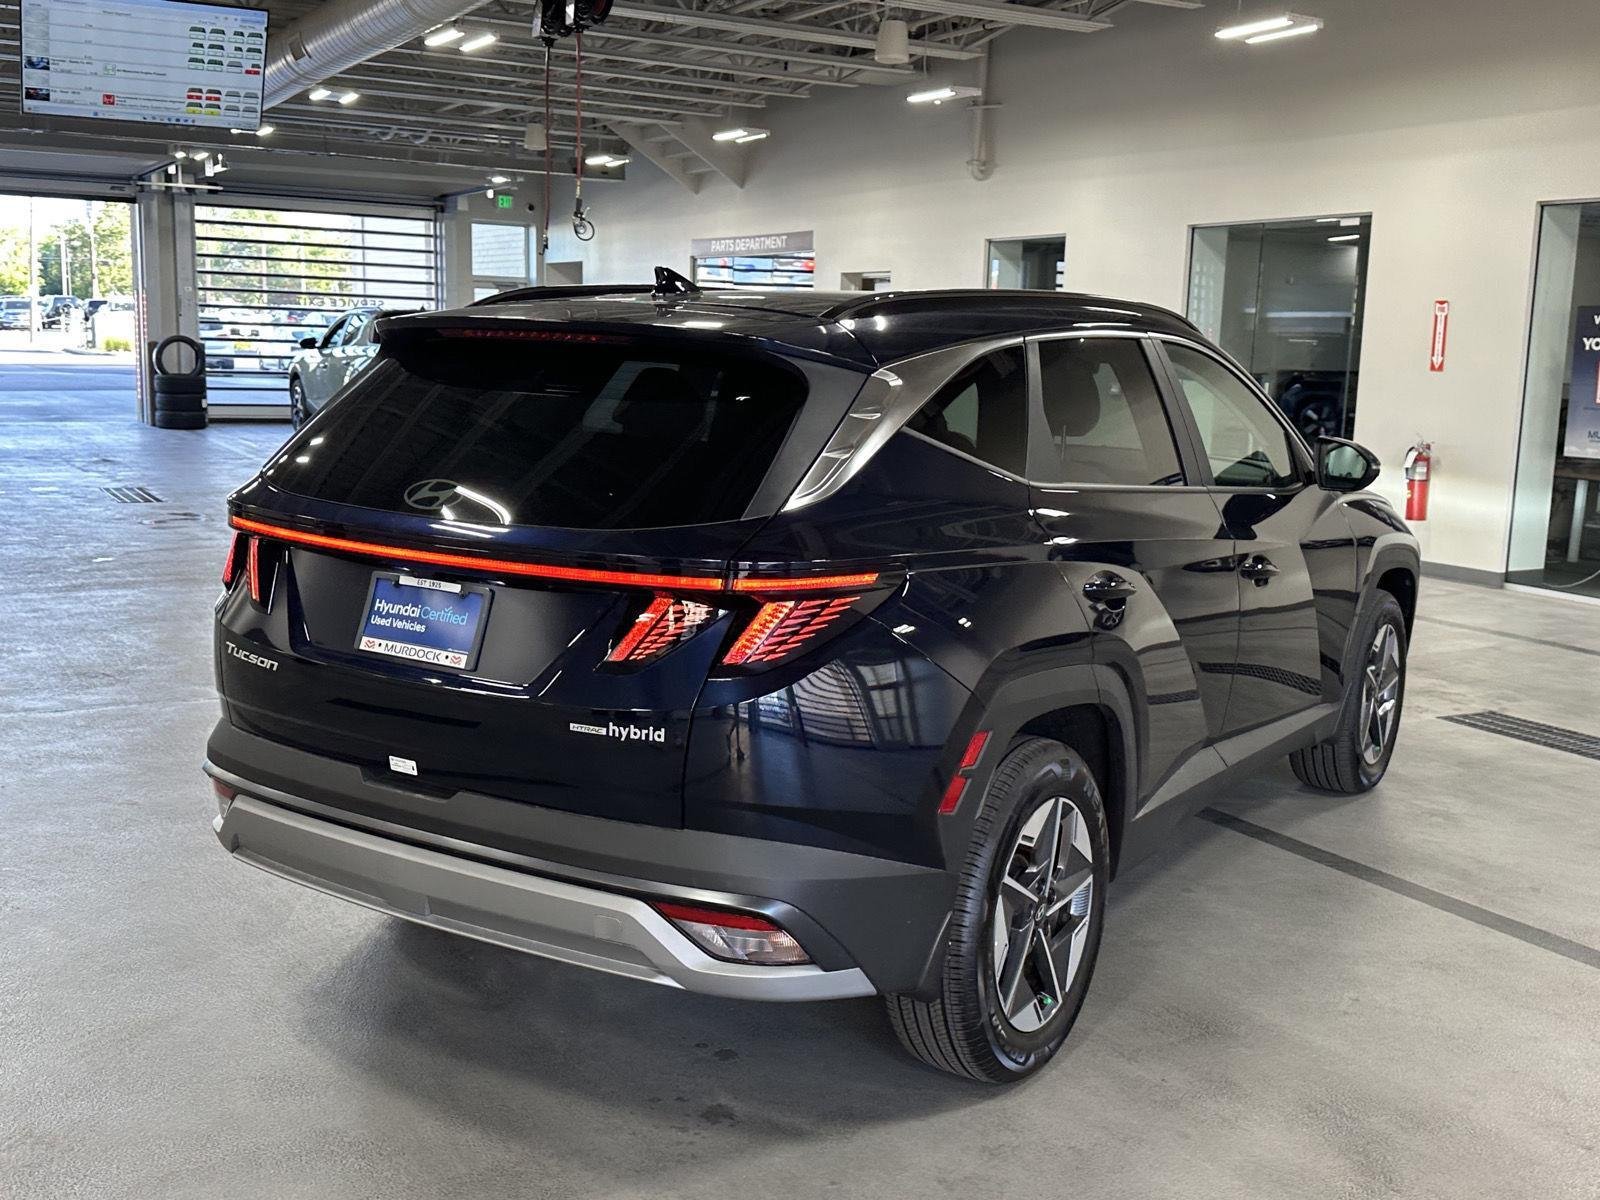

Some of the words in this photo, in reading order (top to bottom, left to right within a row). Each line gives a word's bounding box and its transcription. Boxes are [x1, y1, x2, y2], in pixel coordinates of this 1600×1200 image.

[711, 239, 734, 252] PARTS
[735, 235, 788, 251] DEPARTMENT
[370, 615, 391, 627] Used
[391, 618, 426, 633] Vehicles
[384, 643, 442, 662] MURDOCK
[608, 721, 665, 742] hybrid
